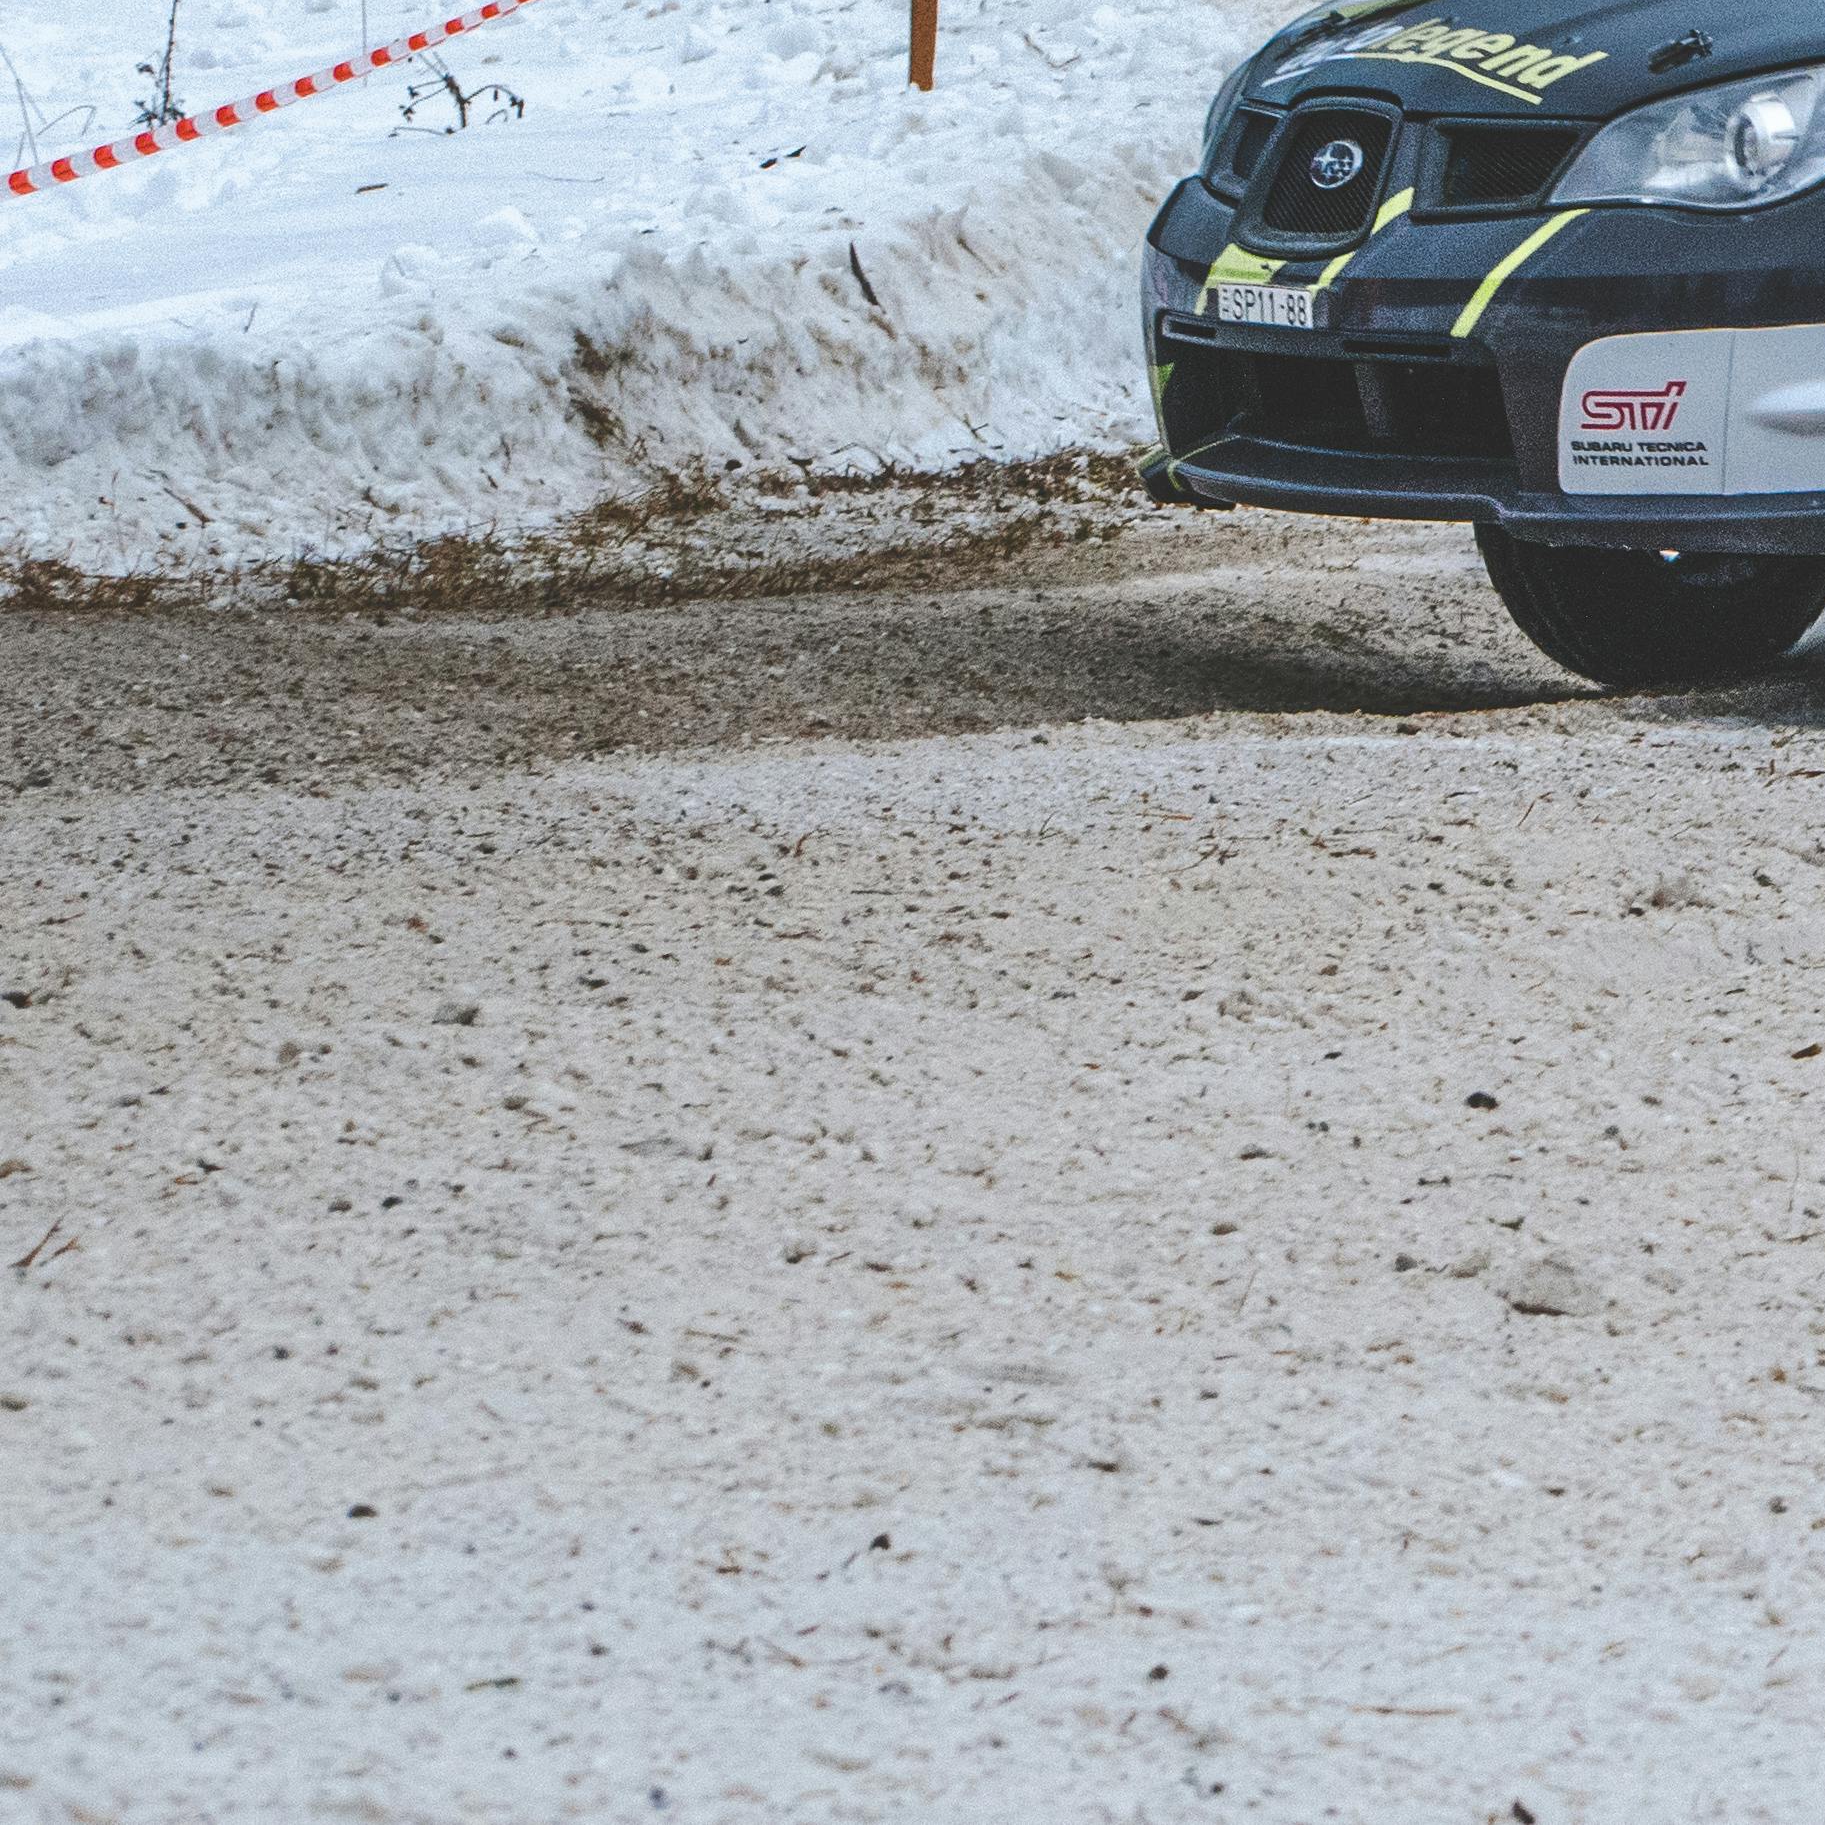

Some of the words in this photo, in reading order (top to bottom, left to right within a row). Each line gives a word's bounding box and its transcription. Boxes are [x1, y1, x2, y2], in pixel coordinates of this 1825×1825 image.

[1233, 289, 1307, 326] SP11-88
[1571, 440, 1633, 453] SUBARU
[1636, 441, 1708, 453] TECNICA
[1573, 454, 1710, 468] INTERNATIONAL
